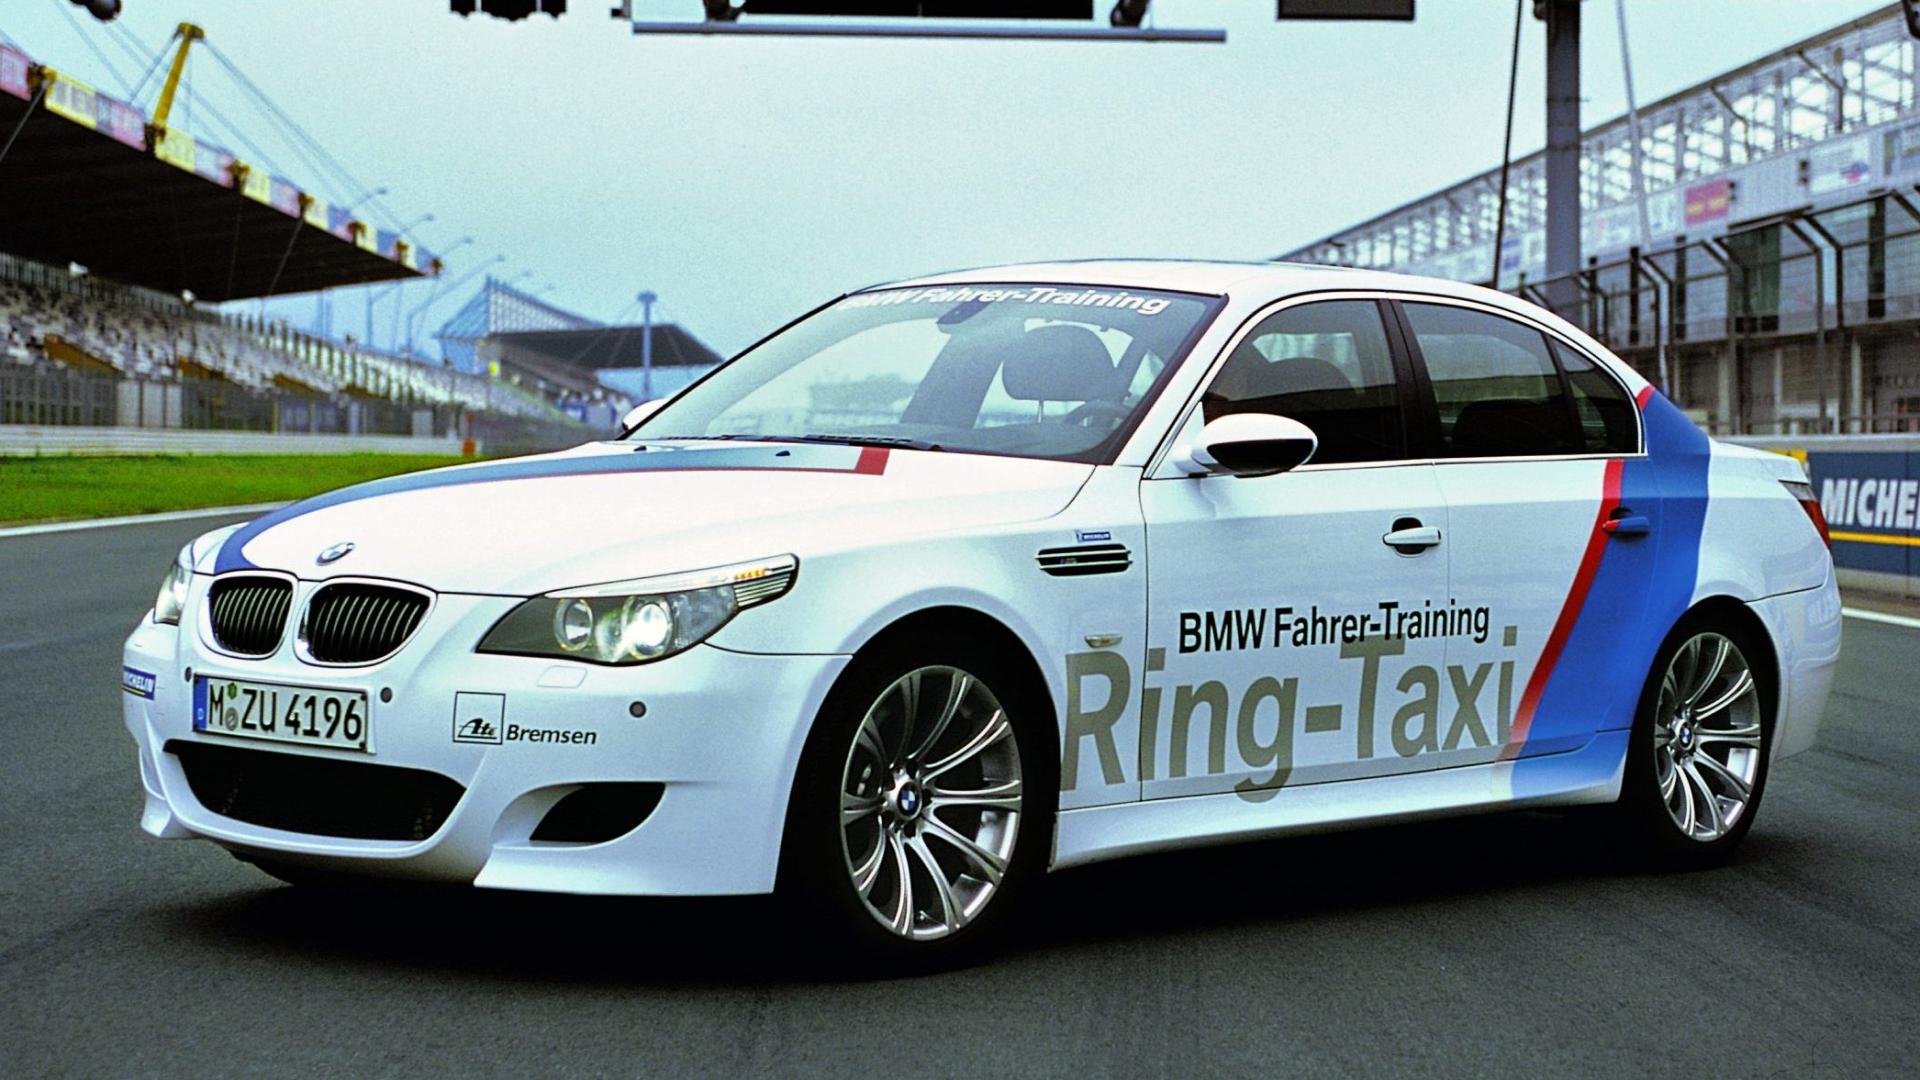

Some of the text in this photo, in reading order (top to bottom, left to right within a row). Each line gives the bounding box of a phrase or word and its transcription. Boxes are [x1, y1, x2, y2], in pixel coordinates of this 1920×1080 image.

[911, 286, 1171, 315] Fahrer-Training
[1820, 478, 1920, 531] MICHE
[1179, 597, 1490, 654] BMW Fahrer-Training
[208, 684, 225, 727] M
[241, 688, 277, 733] ZU
[284, 693, 363, 741] 4196
[505, 724, 597, 745] Bremsen
[1059, 625, 1518, 803] Ring-Taxi
